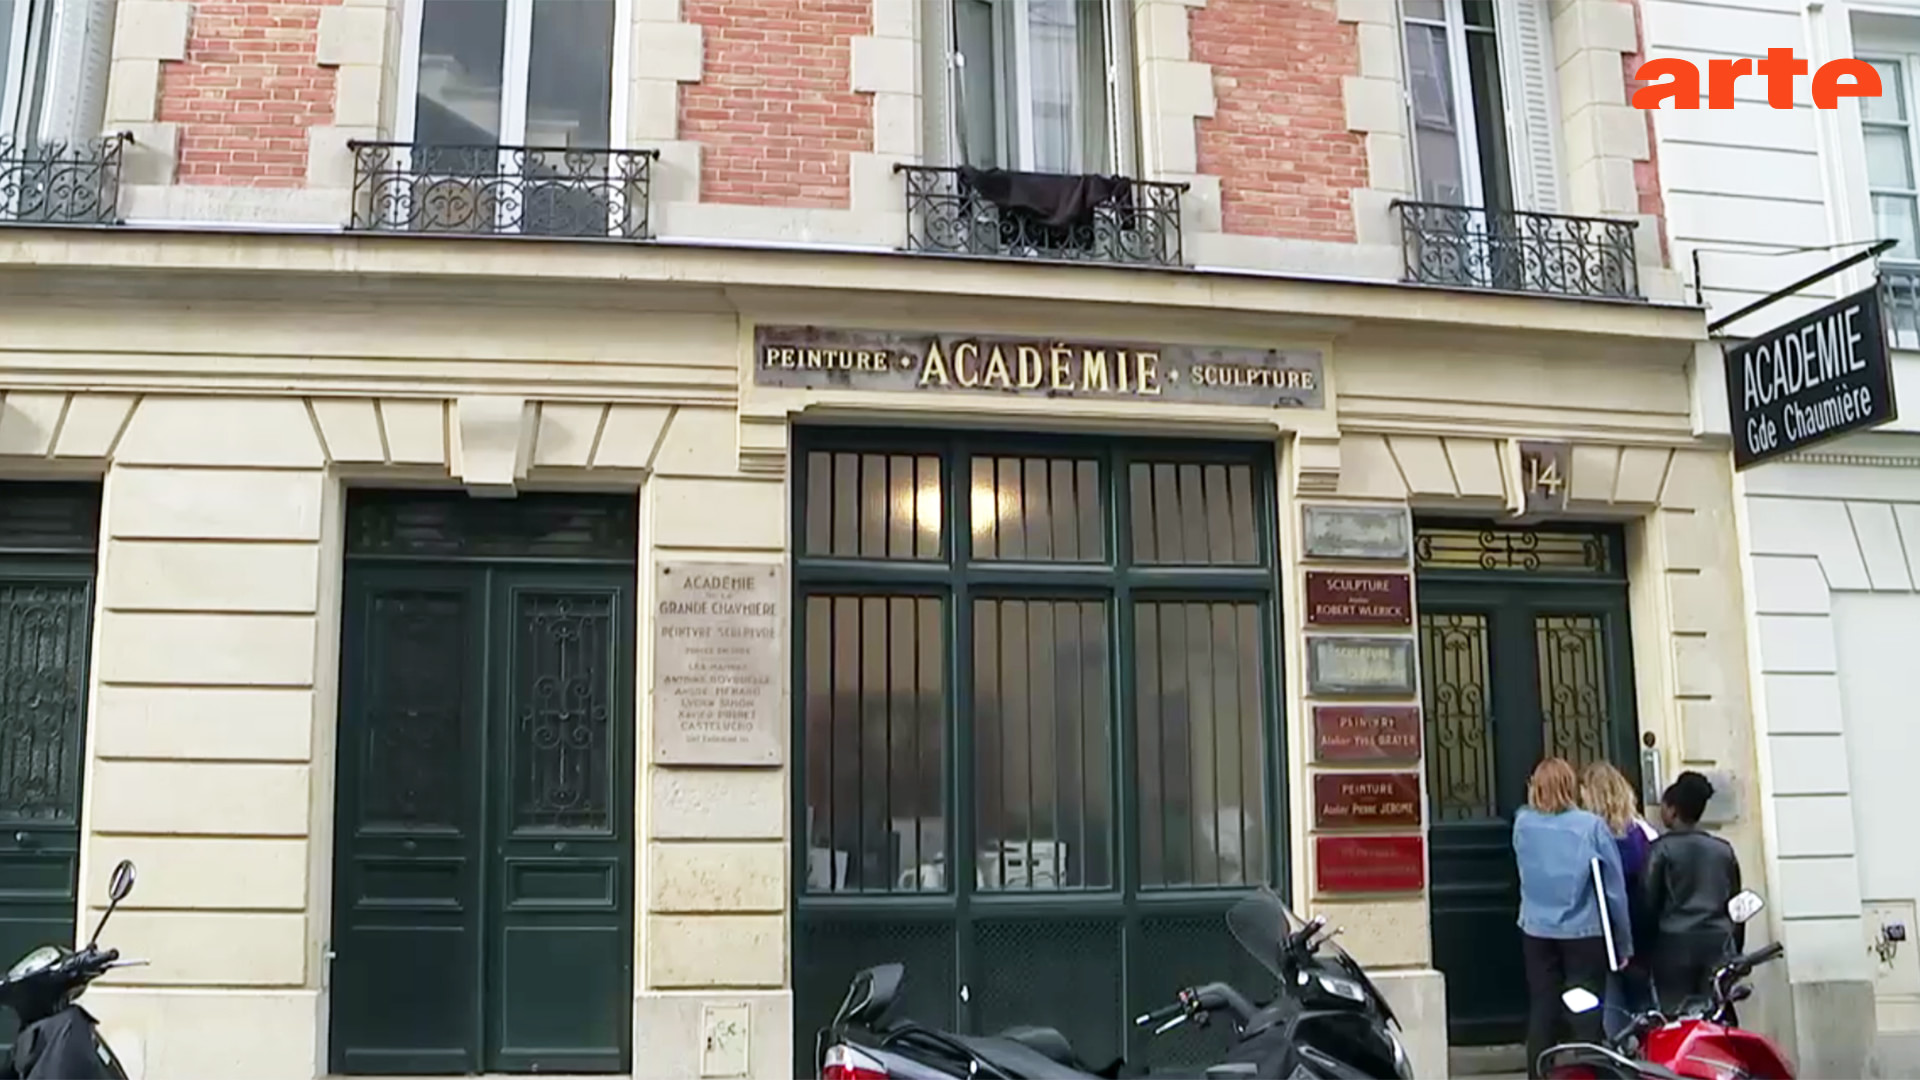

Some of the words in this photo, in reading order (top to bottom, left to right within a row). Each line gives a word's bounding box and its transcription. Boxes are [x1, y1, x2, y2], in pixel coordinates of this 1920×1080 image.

[766, 349, 887, 371] PEINTURE
[920, 341, 1161, 394] ACADÉMIE
[1192, 366, 1314, 390] SCULPTURE
[1744, 305, 1866, 412] ACADEMIE
[1747, 413, 1778, 454] Gde
[1784, 383, 1872, 442] Chaumière
[1530, 457, 1562, 495] 14
[1327, 579, 1390, 592] SCULPTURE
[659, 601, 706, 615] GRANDE
[1316, 605, 1355, 615] ROBERT
[1342, 784, 1393, 795] PEINTURE
